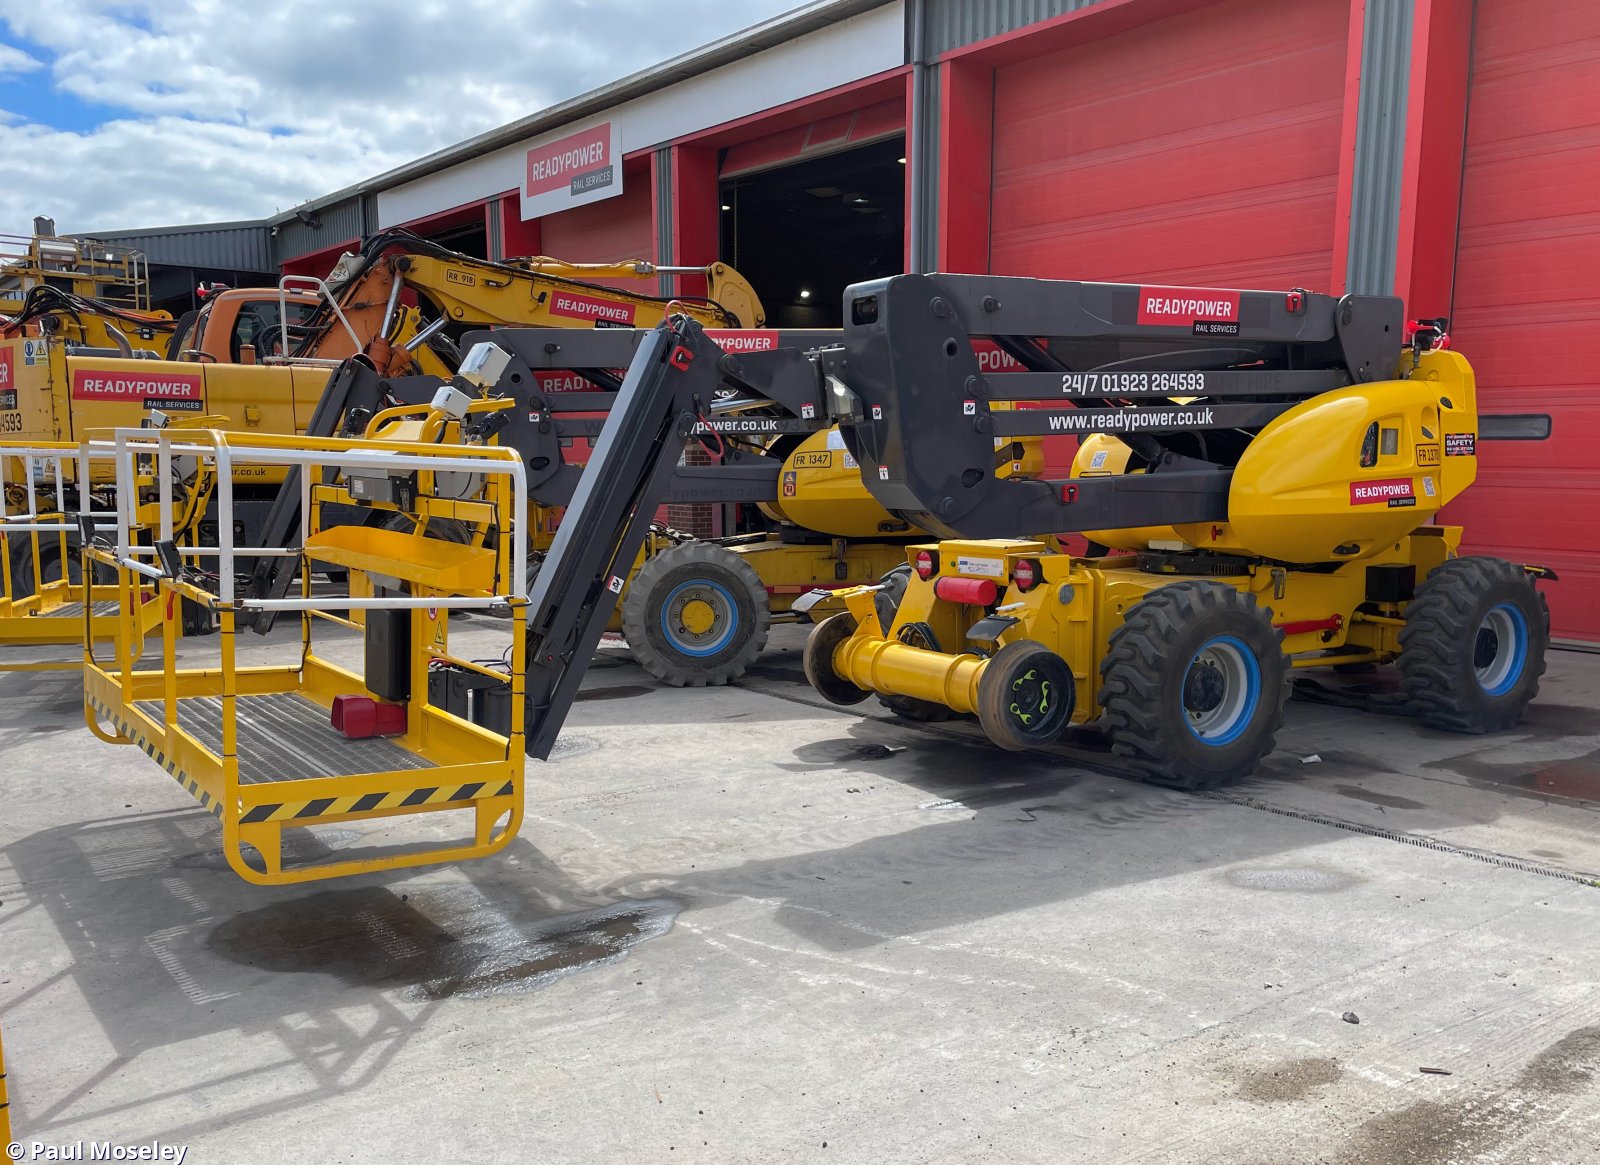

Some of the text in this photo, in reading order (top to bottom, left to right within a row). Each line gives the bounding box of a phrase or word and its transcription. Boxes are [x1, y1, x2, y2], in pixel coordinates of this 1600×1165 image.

[532, 141, 604, 182] READYPOWER
[573, 170, 611, 190] RAIL SERVICES
[448, 272, 474, 284] RR 918
[556, 298, 629, 321] READYPOWER
[1146, 297, 1232, 317] READYPOWER
[1195, 324, 1237, 334] RAIL SERVICES
[83, 379, 192, 396] READYPOWER
[1062, 374, 1097, 396] 24/7
[1101, 373, 1148, 392] 01923
[1151, 373, 1205, 391] 264593
[147, 400, 200, 410] RAIL SERVICES
[1048, 407, 1214, 432] www.readypower.co.uk
[1446, 439, 1474, 447] SAFETY
[796, 454, 829, 466] FR 1347
[1418, 448, 1427, 461] FR
[231, 467, 266, 477] r.co.uk
[1355, 485, 1410, 498] READYPOWER
